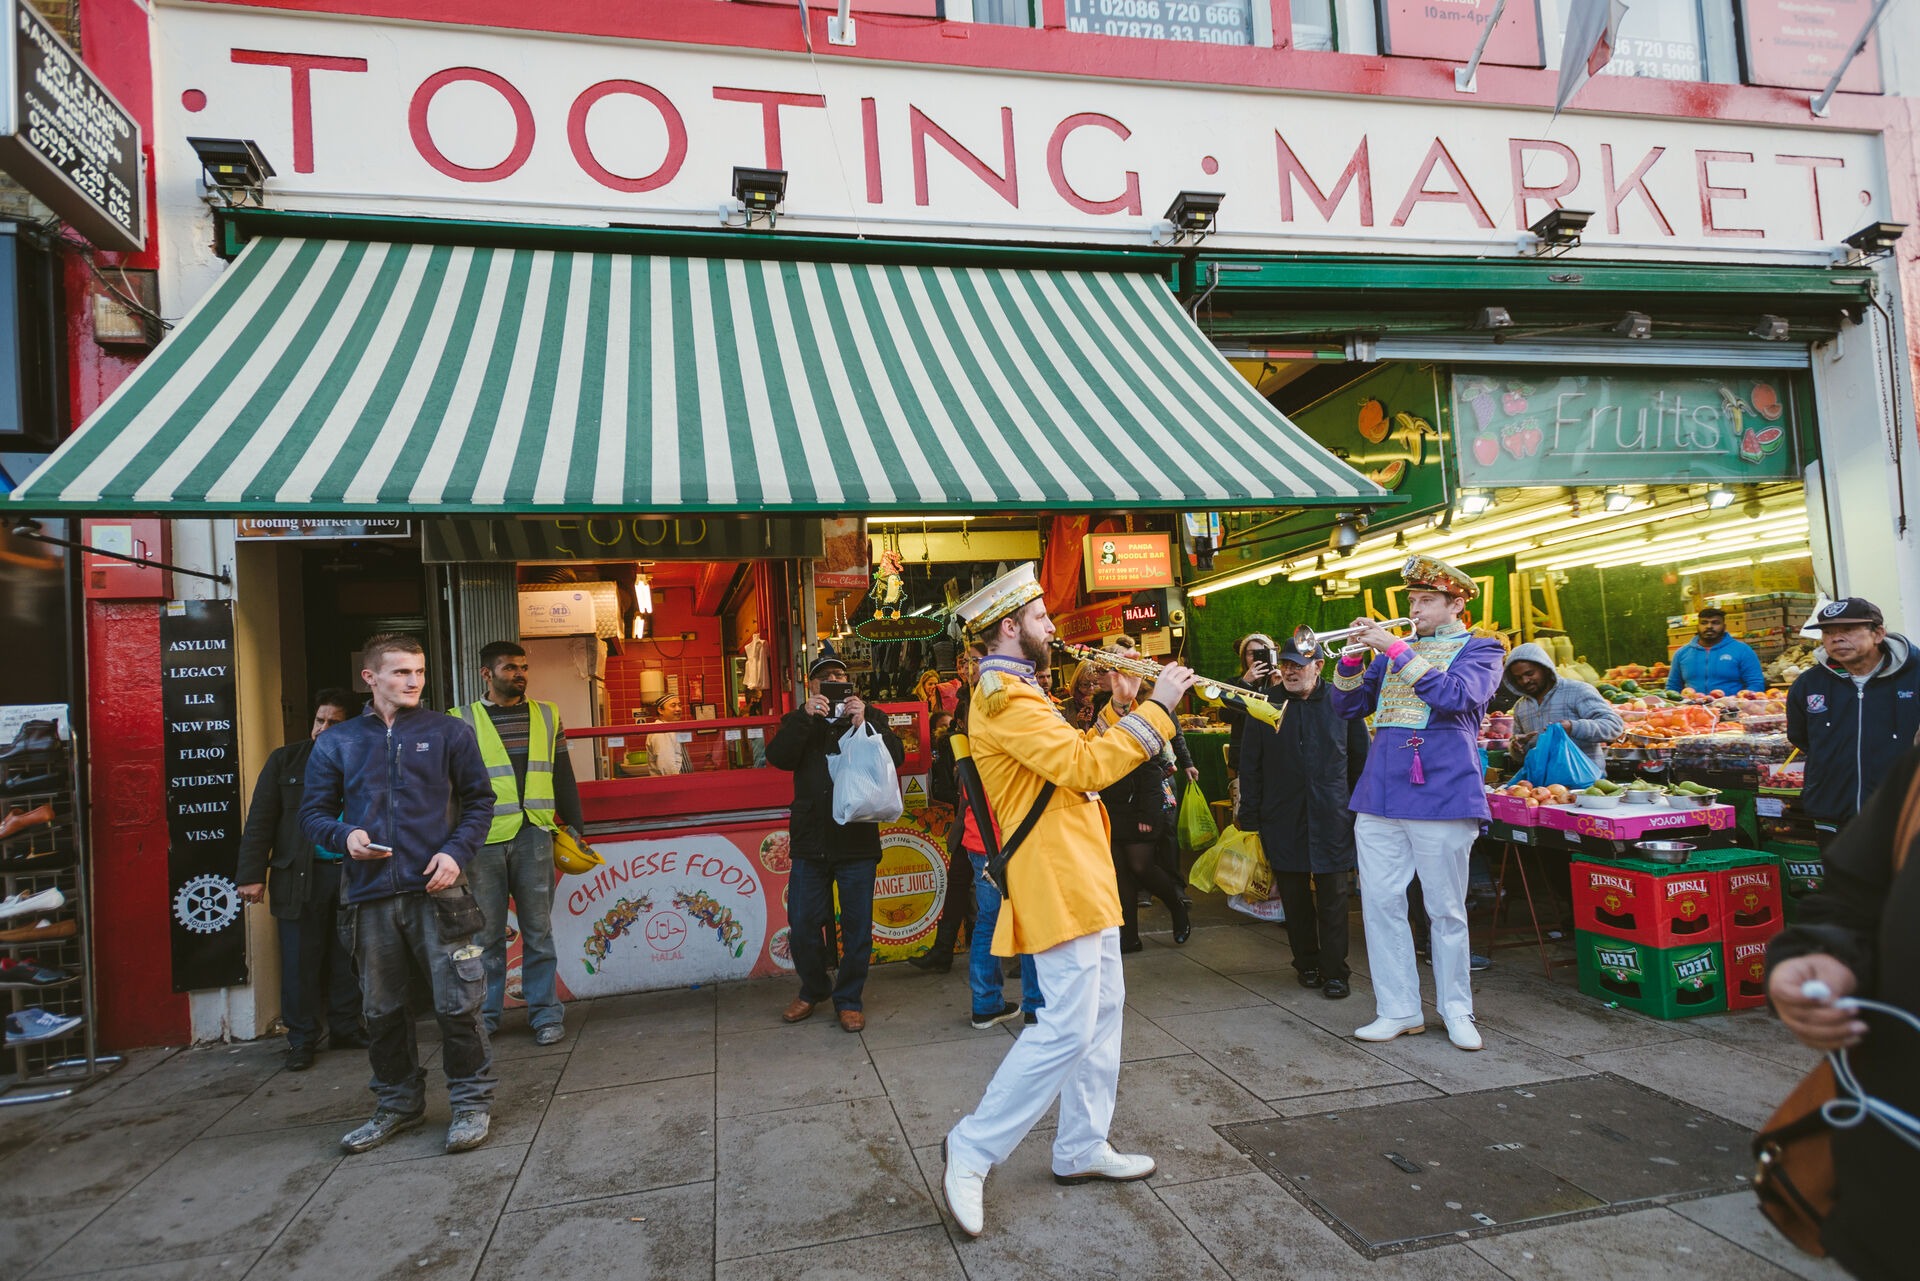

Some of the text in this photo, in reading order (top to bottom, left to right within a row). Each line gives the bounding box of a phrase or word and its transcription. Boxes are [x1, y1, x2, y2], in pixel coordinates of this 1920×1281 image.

[1100, 0, 1160, 20] 02086
[1165, 3, 1201, 22] 720
[1205, 6, 1241, 26] 666
[1070, 17, 1088, 33] M
[1105, 20, 1165, 40] 07878
[1170, 25, 1194, 42] 33
[1199, 27, 1246, 46] 5000
[1635, 40, 1663, 58] 720
[1667, 43, 1696, 61] 666
[21, 10, 130, 138] RASHID & RASHID
[1662, 64, 1700, 81] 5000
[44, 57, 115, 141] SOLICITORS
[36, 67, 123, 164] IMMIGRATION
[56, 105, 108, 164] ASYLUM
[230, 48, 1845, 240] TOOTING MARKET
[29, 110, 131, 213] 02086 720 666
[29, 128, 131, 229] 0777 4222 062
[1554, 390, 1720, 449] Fruits
[1117, 551, 1165, 560] NOODLE BAR
[169, 639, 226, 652] ASYLUM
[170, 665, 227, 679] LEGACY
[184, 693, 215, 705] I.L.R
[171, 719, 231, 733] NEW PBS
[179, 746, 225, 760] FLR(O)
[171, 773, 234, 788] STUDENT
[178, 800, 229, 815] FAMILY
[1649, 815, 1686, 826] MOYCA
[185, 829, 225, 842] VISAS
[1789, 863, 1824, 876] LECH
[568, 851, 757, 916] CHINESE FOOD
[906, 873, 935, 892] JUICE
[1590, 873, 1633, 893] TYSKIE
[1667, 879, 1707, 896] TYSKIE
[1730, 872, 1770, 890] TYSKIE
[187, 914, 229, 928] SOLICITORS
[651, 952, 685, 962] HALAL
[1600, 951, 1635, 967] LECH
[1678, 956, 1711, 977] LECH
